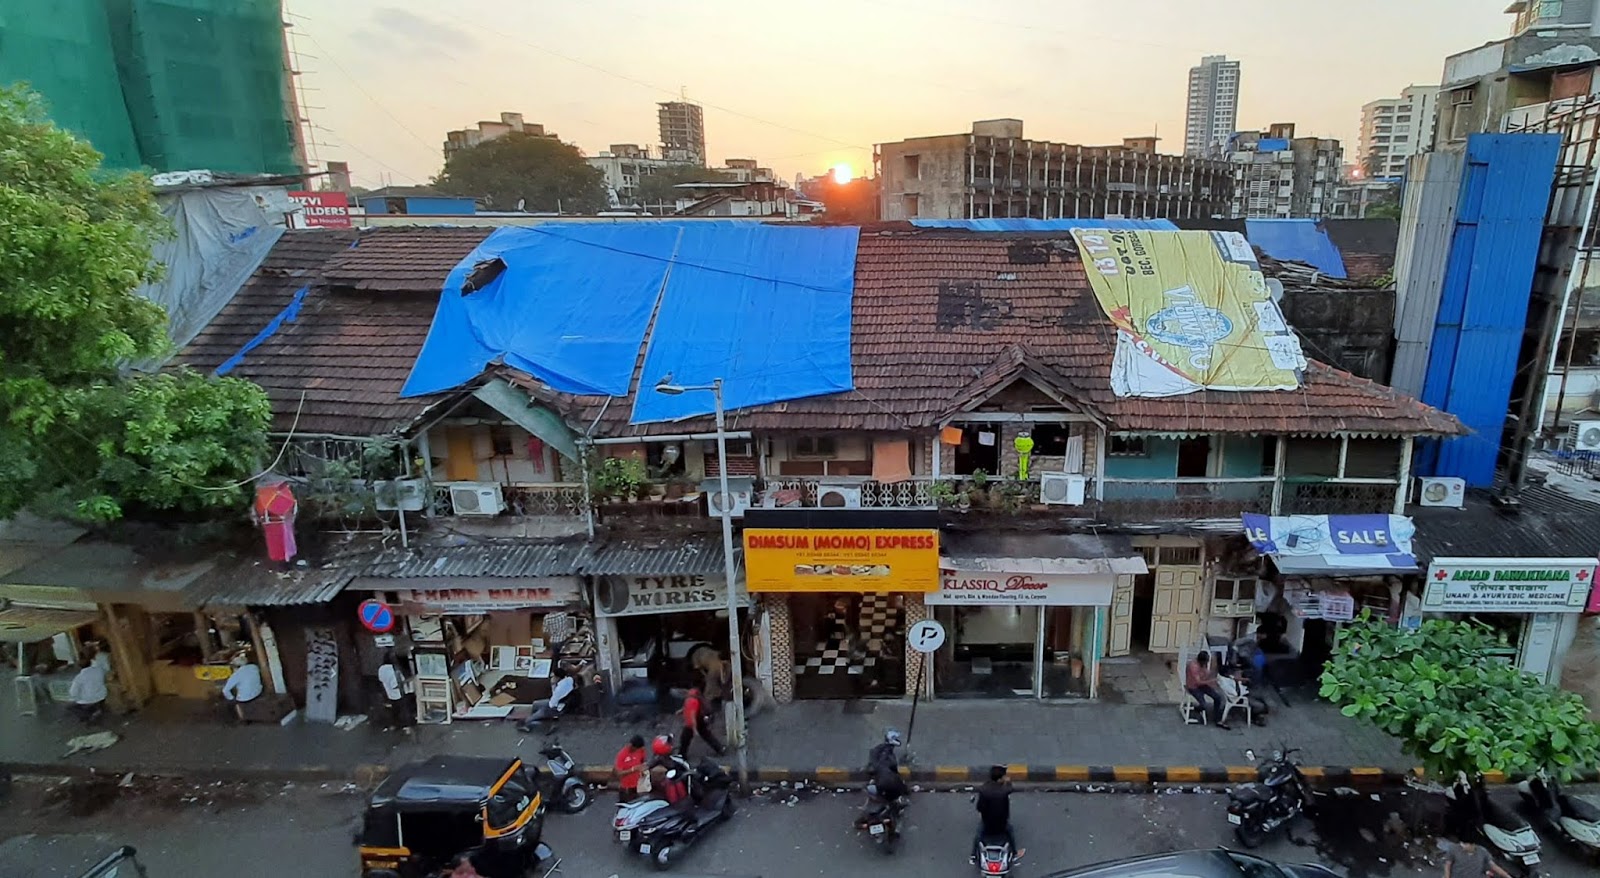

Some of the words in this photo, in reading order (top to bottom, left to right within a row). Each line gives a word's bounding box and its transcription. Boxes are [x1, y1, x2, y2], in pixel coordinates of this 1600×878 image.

[303, 206, 346, 216] ILDERS
[1163, 284, 1210, 370] OLYMPIA
[813, 535, 871, 551] (MOMO)
[875, 535, 934, 549] EXPRESS
[1337, 530, 1388, 545] SALE
[634, 575, 705, 590] TYRE
[943, 578, 1006, 593] KLASSIQ
[1004, 575, 1048, 590] Decor
